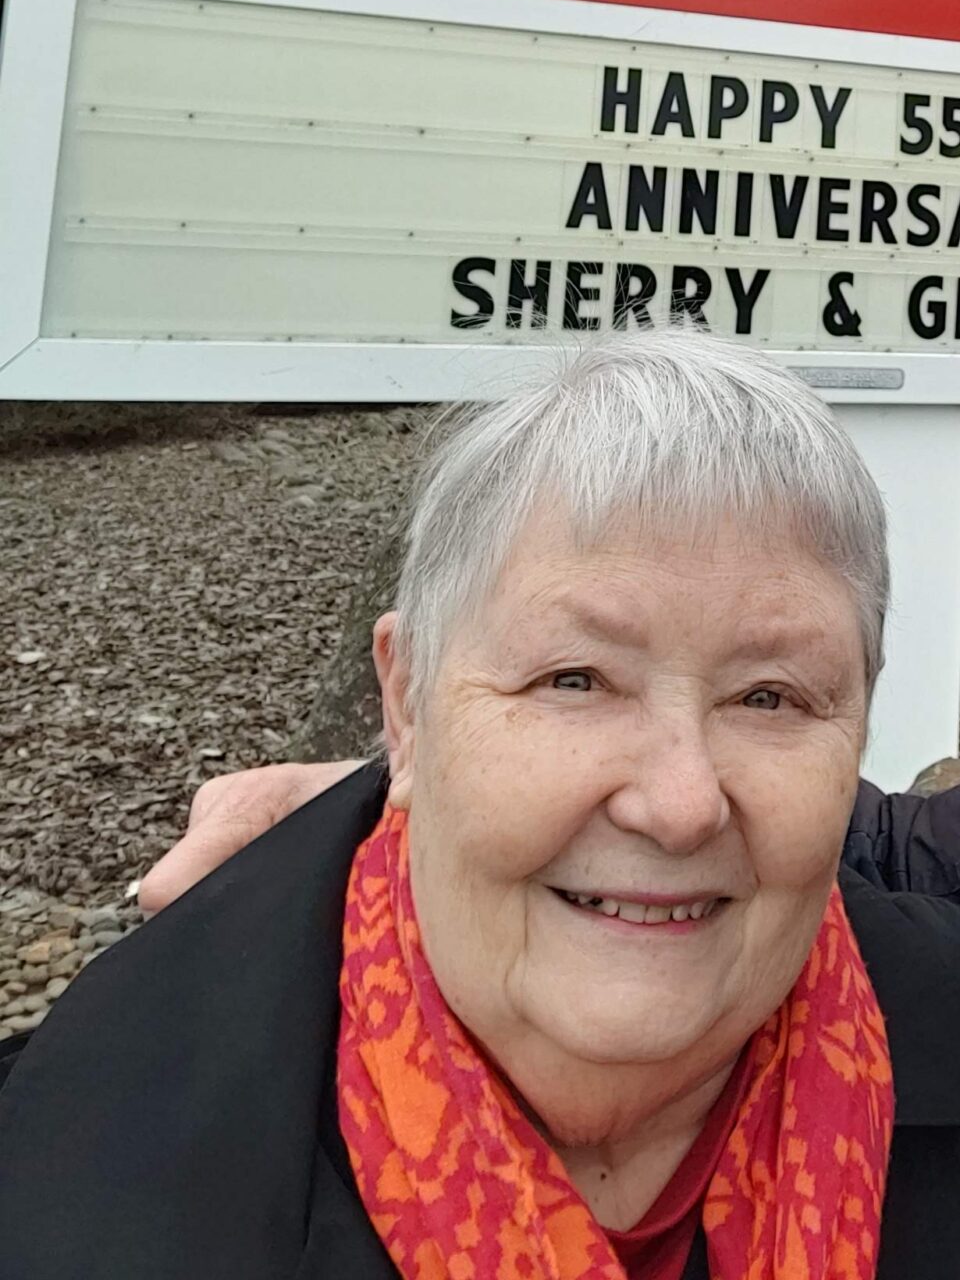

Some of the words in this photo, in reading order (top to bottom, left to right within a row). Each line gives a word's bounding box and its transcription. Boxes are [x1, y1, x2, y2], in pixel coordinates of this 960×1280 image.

[600, 66, 852, 149] HAPPY
[450, 257, 771, 335] SHERRY
[822, 271, 863, 337] &
